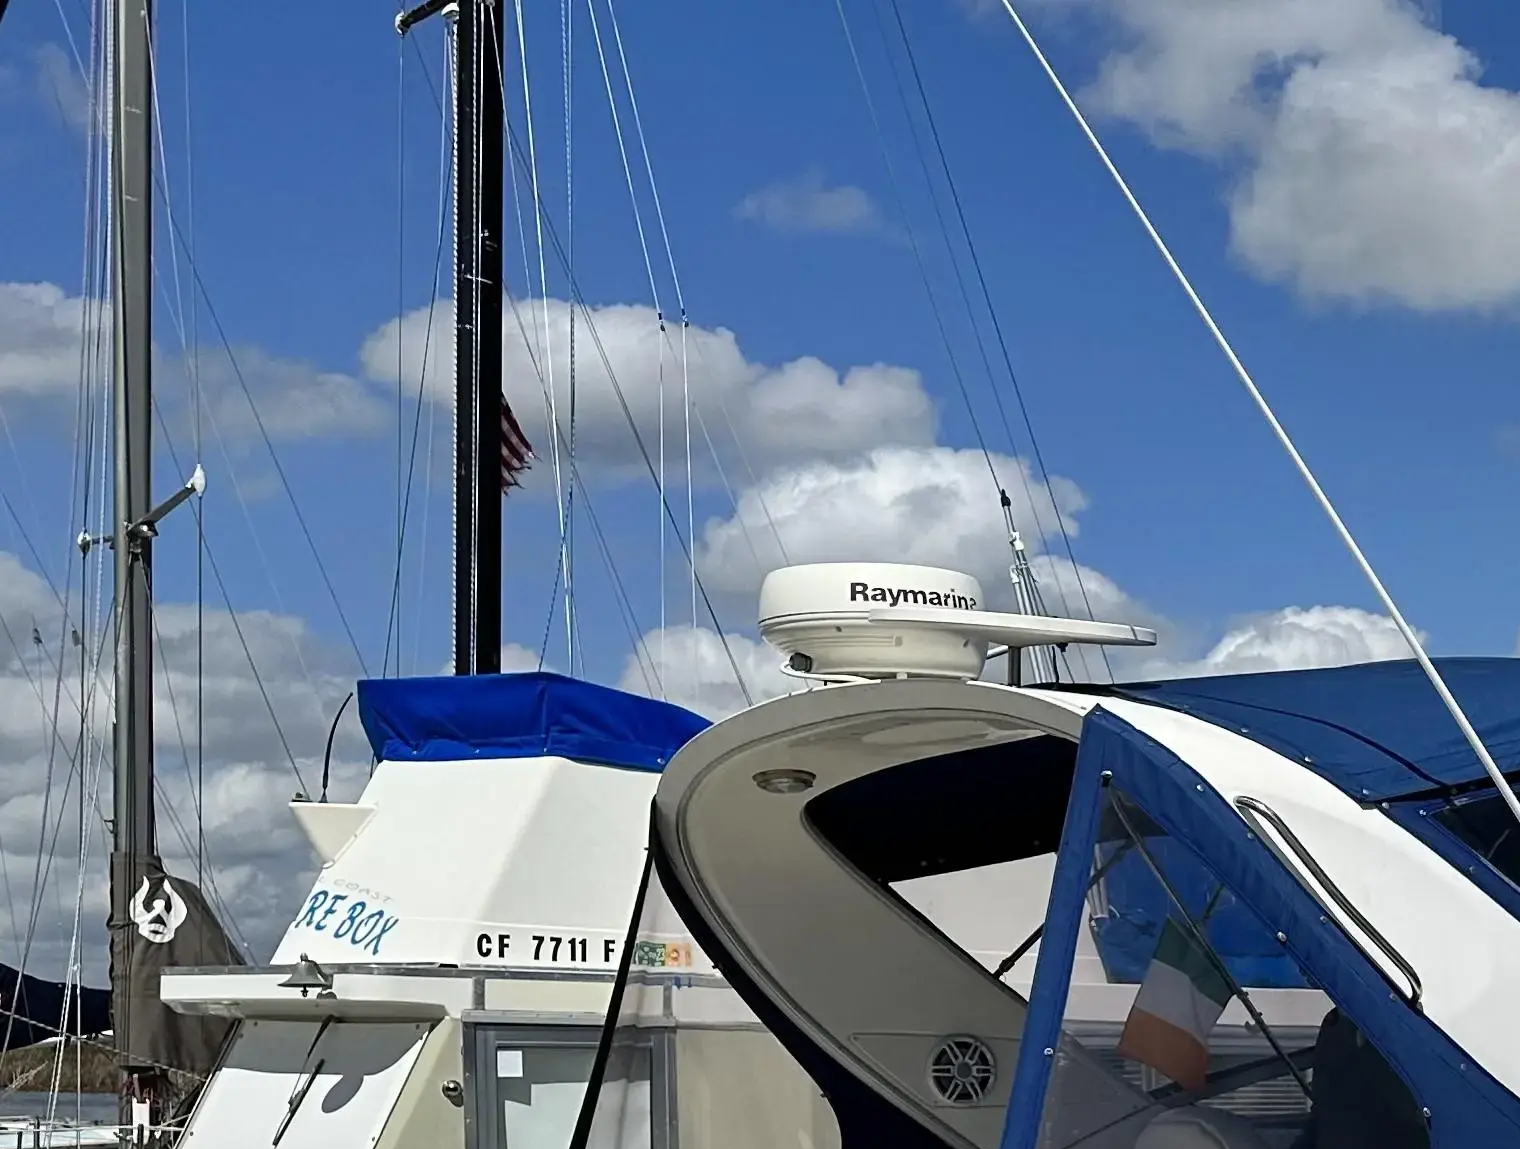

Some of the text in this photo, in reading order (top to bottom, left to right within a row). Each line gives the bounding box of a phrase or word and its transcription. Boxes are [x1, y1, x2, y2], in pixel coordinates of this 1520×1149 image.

[333, 900, 400, 956] BOX
[476, 933, 511, 959] CF
[532, 935, 587, 963] 7711
